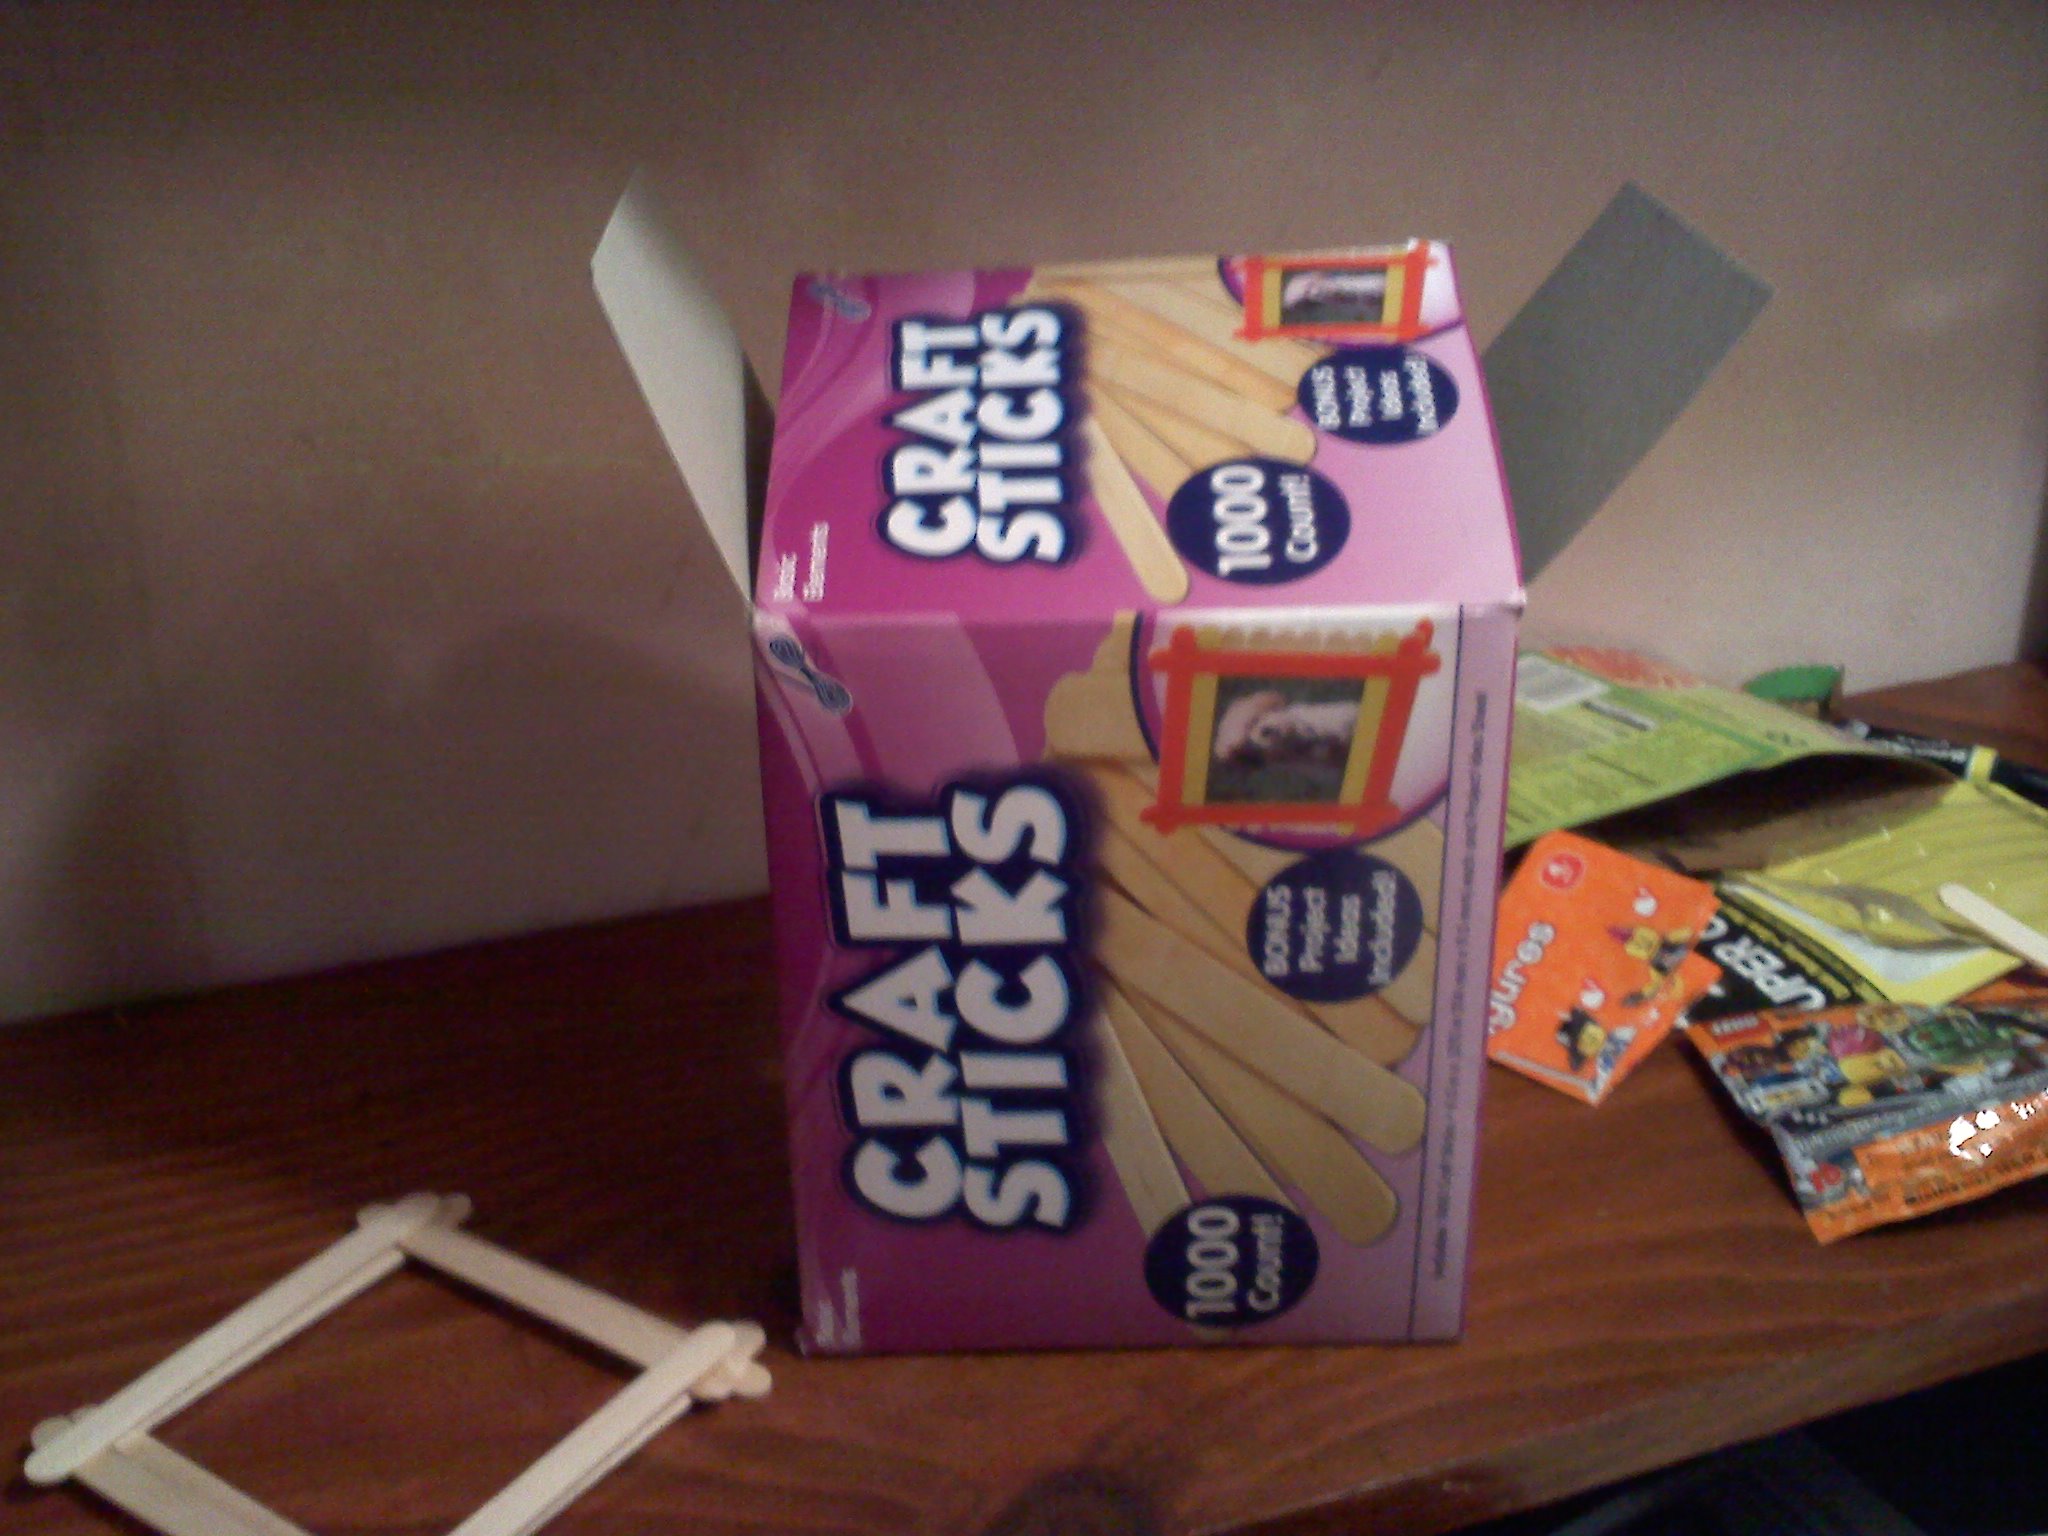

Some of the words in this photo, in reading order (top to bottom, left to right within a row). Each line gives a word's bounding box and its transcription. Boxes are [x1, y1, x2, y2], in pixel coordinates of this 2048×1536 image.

[888, 320, 980, 557] CRAFT
[976, 307, 1066, 562] STICKS
[1211, 464, 1274, 578] 1000
[834, 798, 964, 1221] CRAFT
[950, 783, 1071, 1229] STICKS
[1489, 920, 1556, 1036] gures
[1185, 1204, 1241, 1320] 1000
